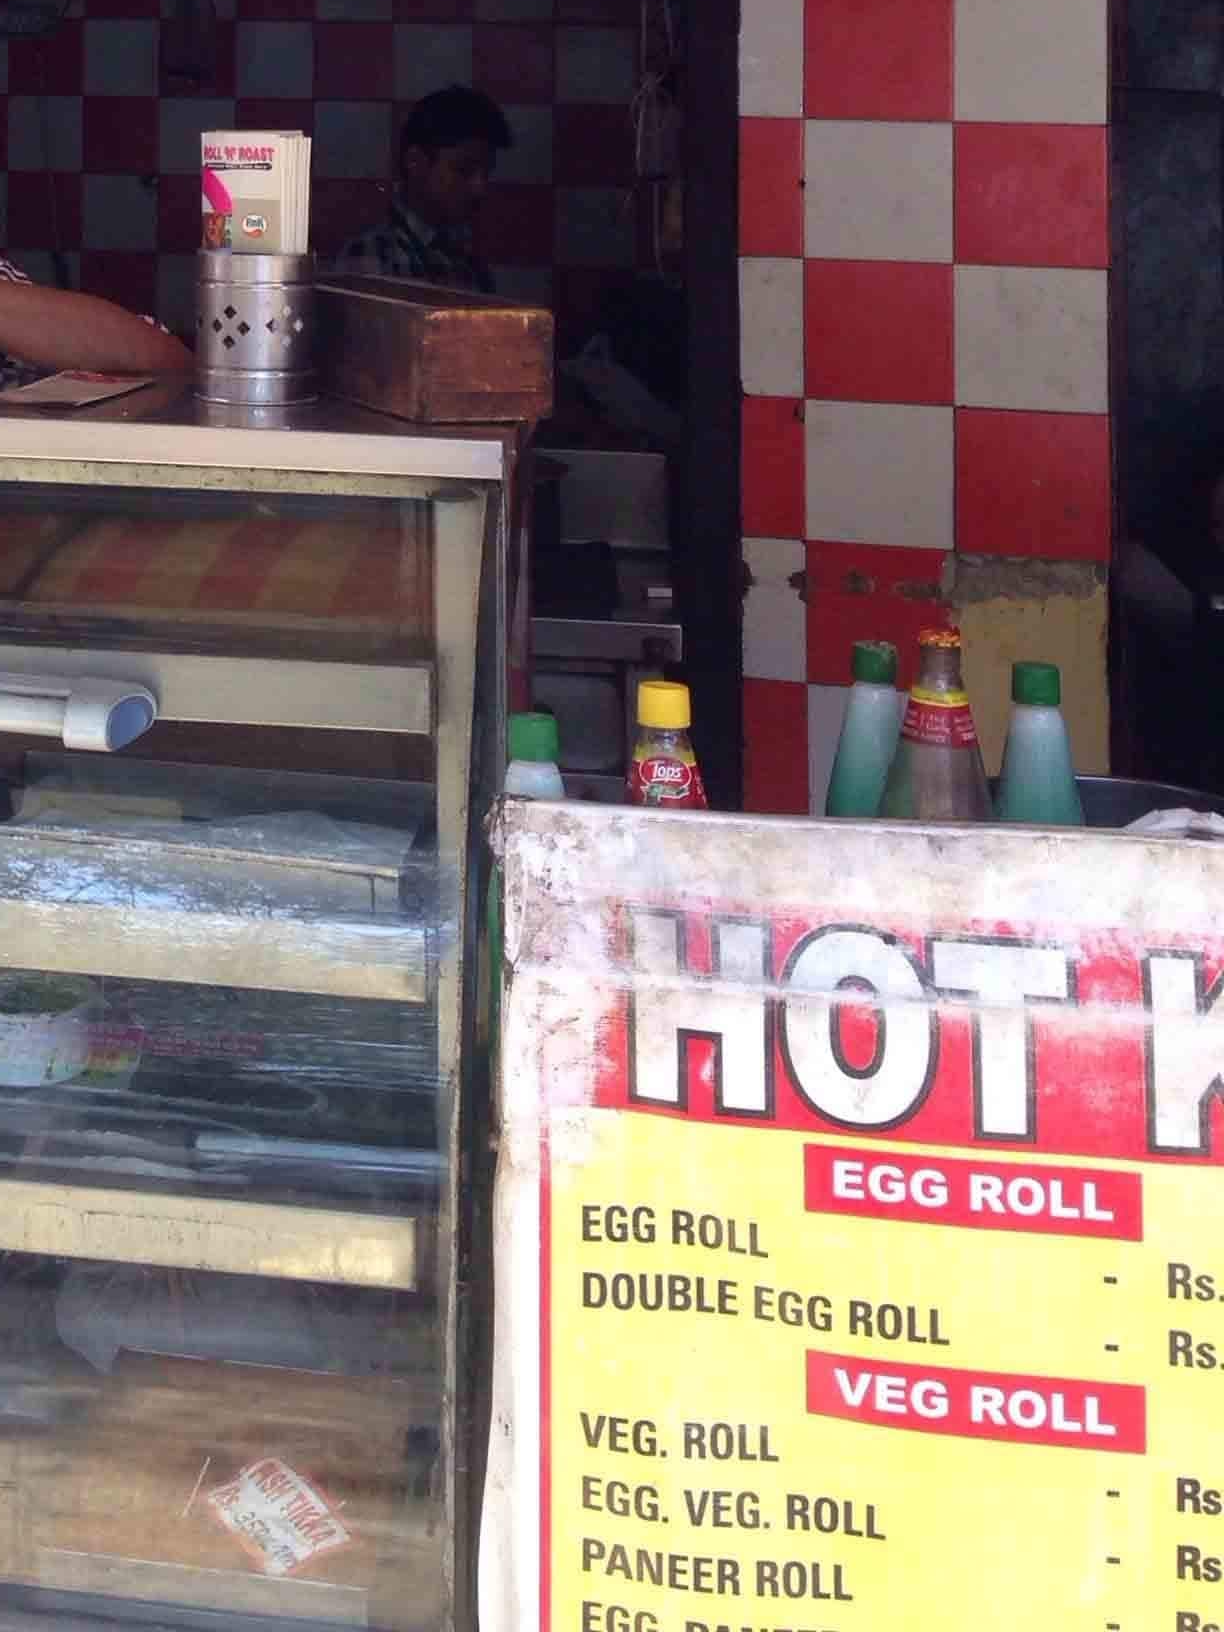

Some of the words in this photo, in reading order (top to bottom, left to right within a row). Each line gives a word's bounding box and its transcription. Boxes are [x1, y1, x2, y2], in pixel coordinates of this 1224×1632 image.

[239, 146, 274, 161] ROAST
[648, 761, 682, 778] Tops
[627, 902, 1076, 1144] HOT
[832, 1159, 949, 1207] EGG
[970, 1173, 1114, 1221] ROLL
[582, 1206, 655, 1243] EGG
[672, 1210, 768, 1258] ROLL
[583, 1272, 738, 1315] DOUBLE
[754, 1286, 832, 1331] EGG
[849, 1301, 949, 1345] ROLL
[835, 1368, 948, 1417] VEG
[971, 1386, 1116, 1435] ROLL
[580, 1412, 666, 1457] VEG.
[684, 1423, 779, 1462] ROLL
[582, 1476, 669, 1523] EGG.
[684, 1490, 770, 1529] VEG.
[787, 1494, 886, 1540] ROLL
[582, 1538, 740, 1596] PANEER
[756, 1561, 853, 1601] ROLL
